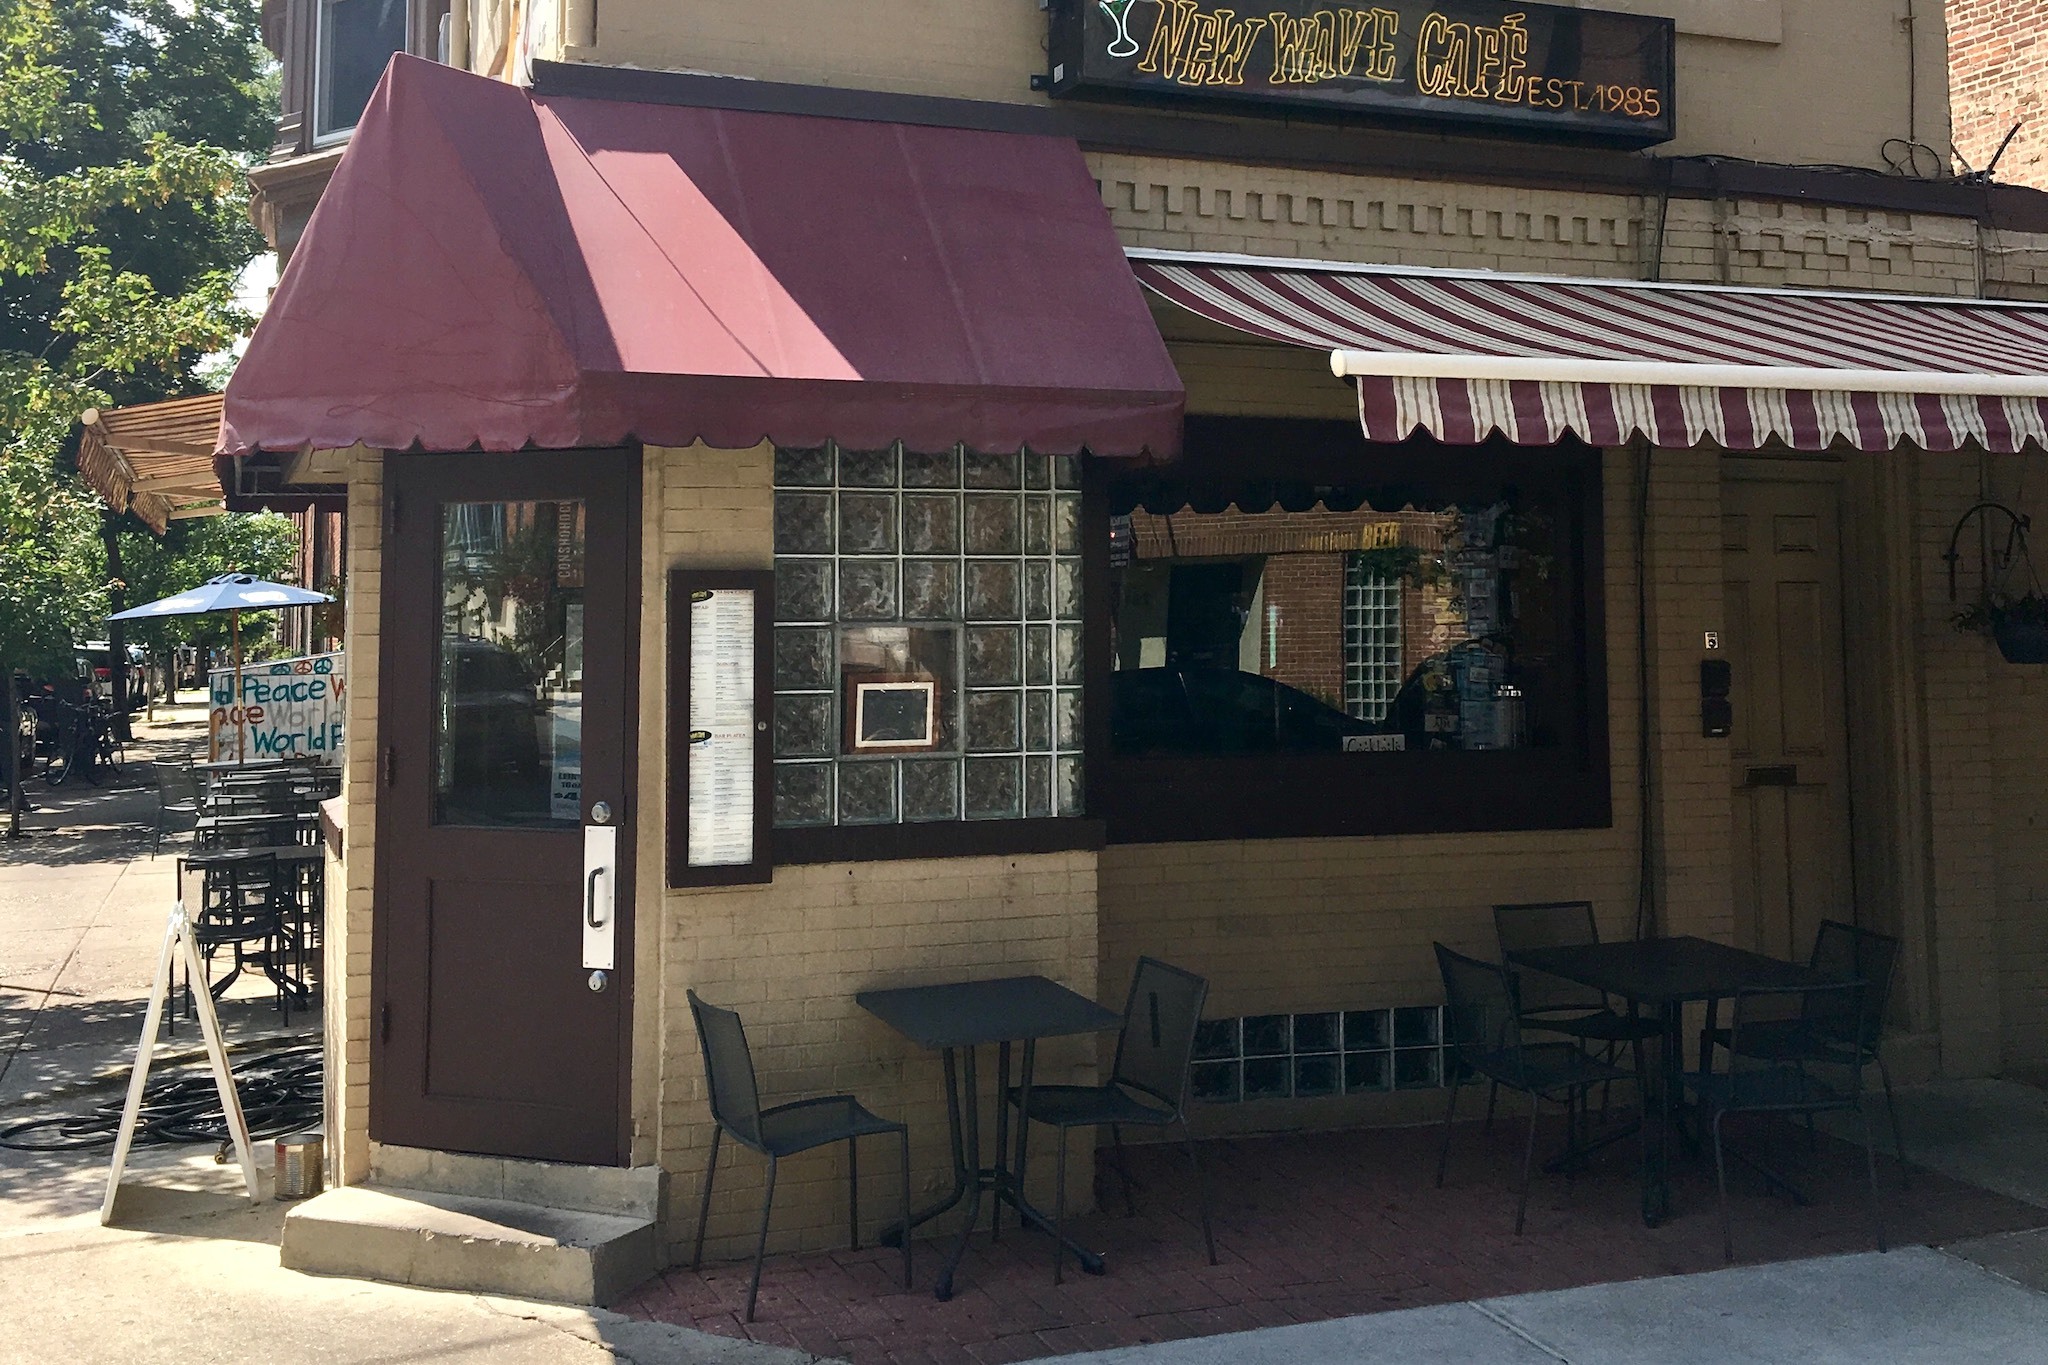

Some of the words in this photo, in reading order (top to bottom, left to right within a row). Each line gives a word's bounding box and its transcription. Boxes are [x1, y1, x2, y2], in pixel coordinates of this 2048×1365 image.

[1137, 0, 1267, 86] NEW
[1269, 8, 1398, 84] WAVE
[1416, 12, 1528, 102] CAFÉ
[1597, 84, 1661, 117] 1985
[242, 673, 326, 704] Peace
[251, 722, 326, 754] World
